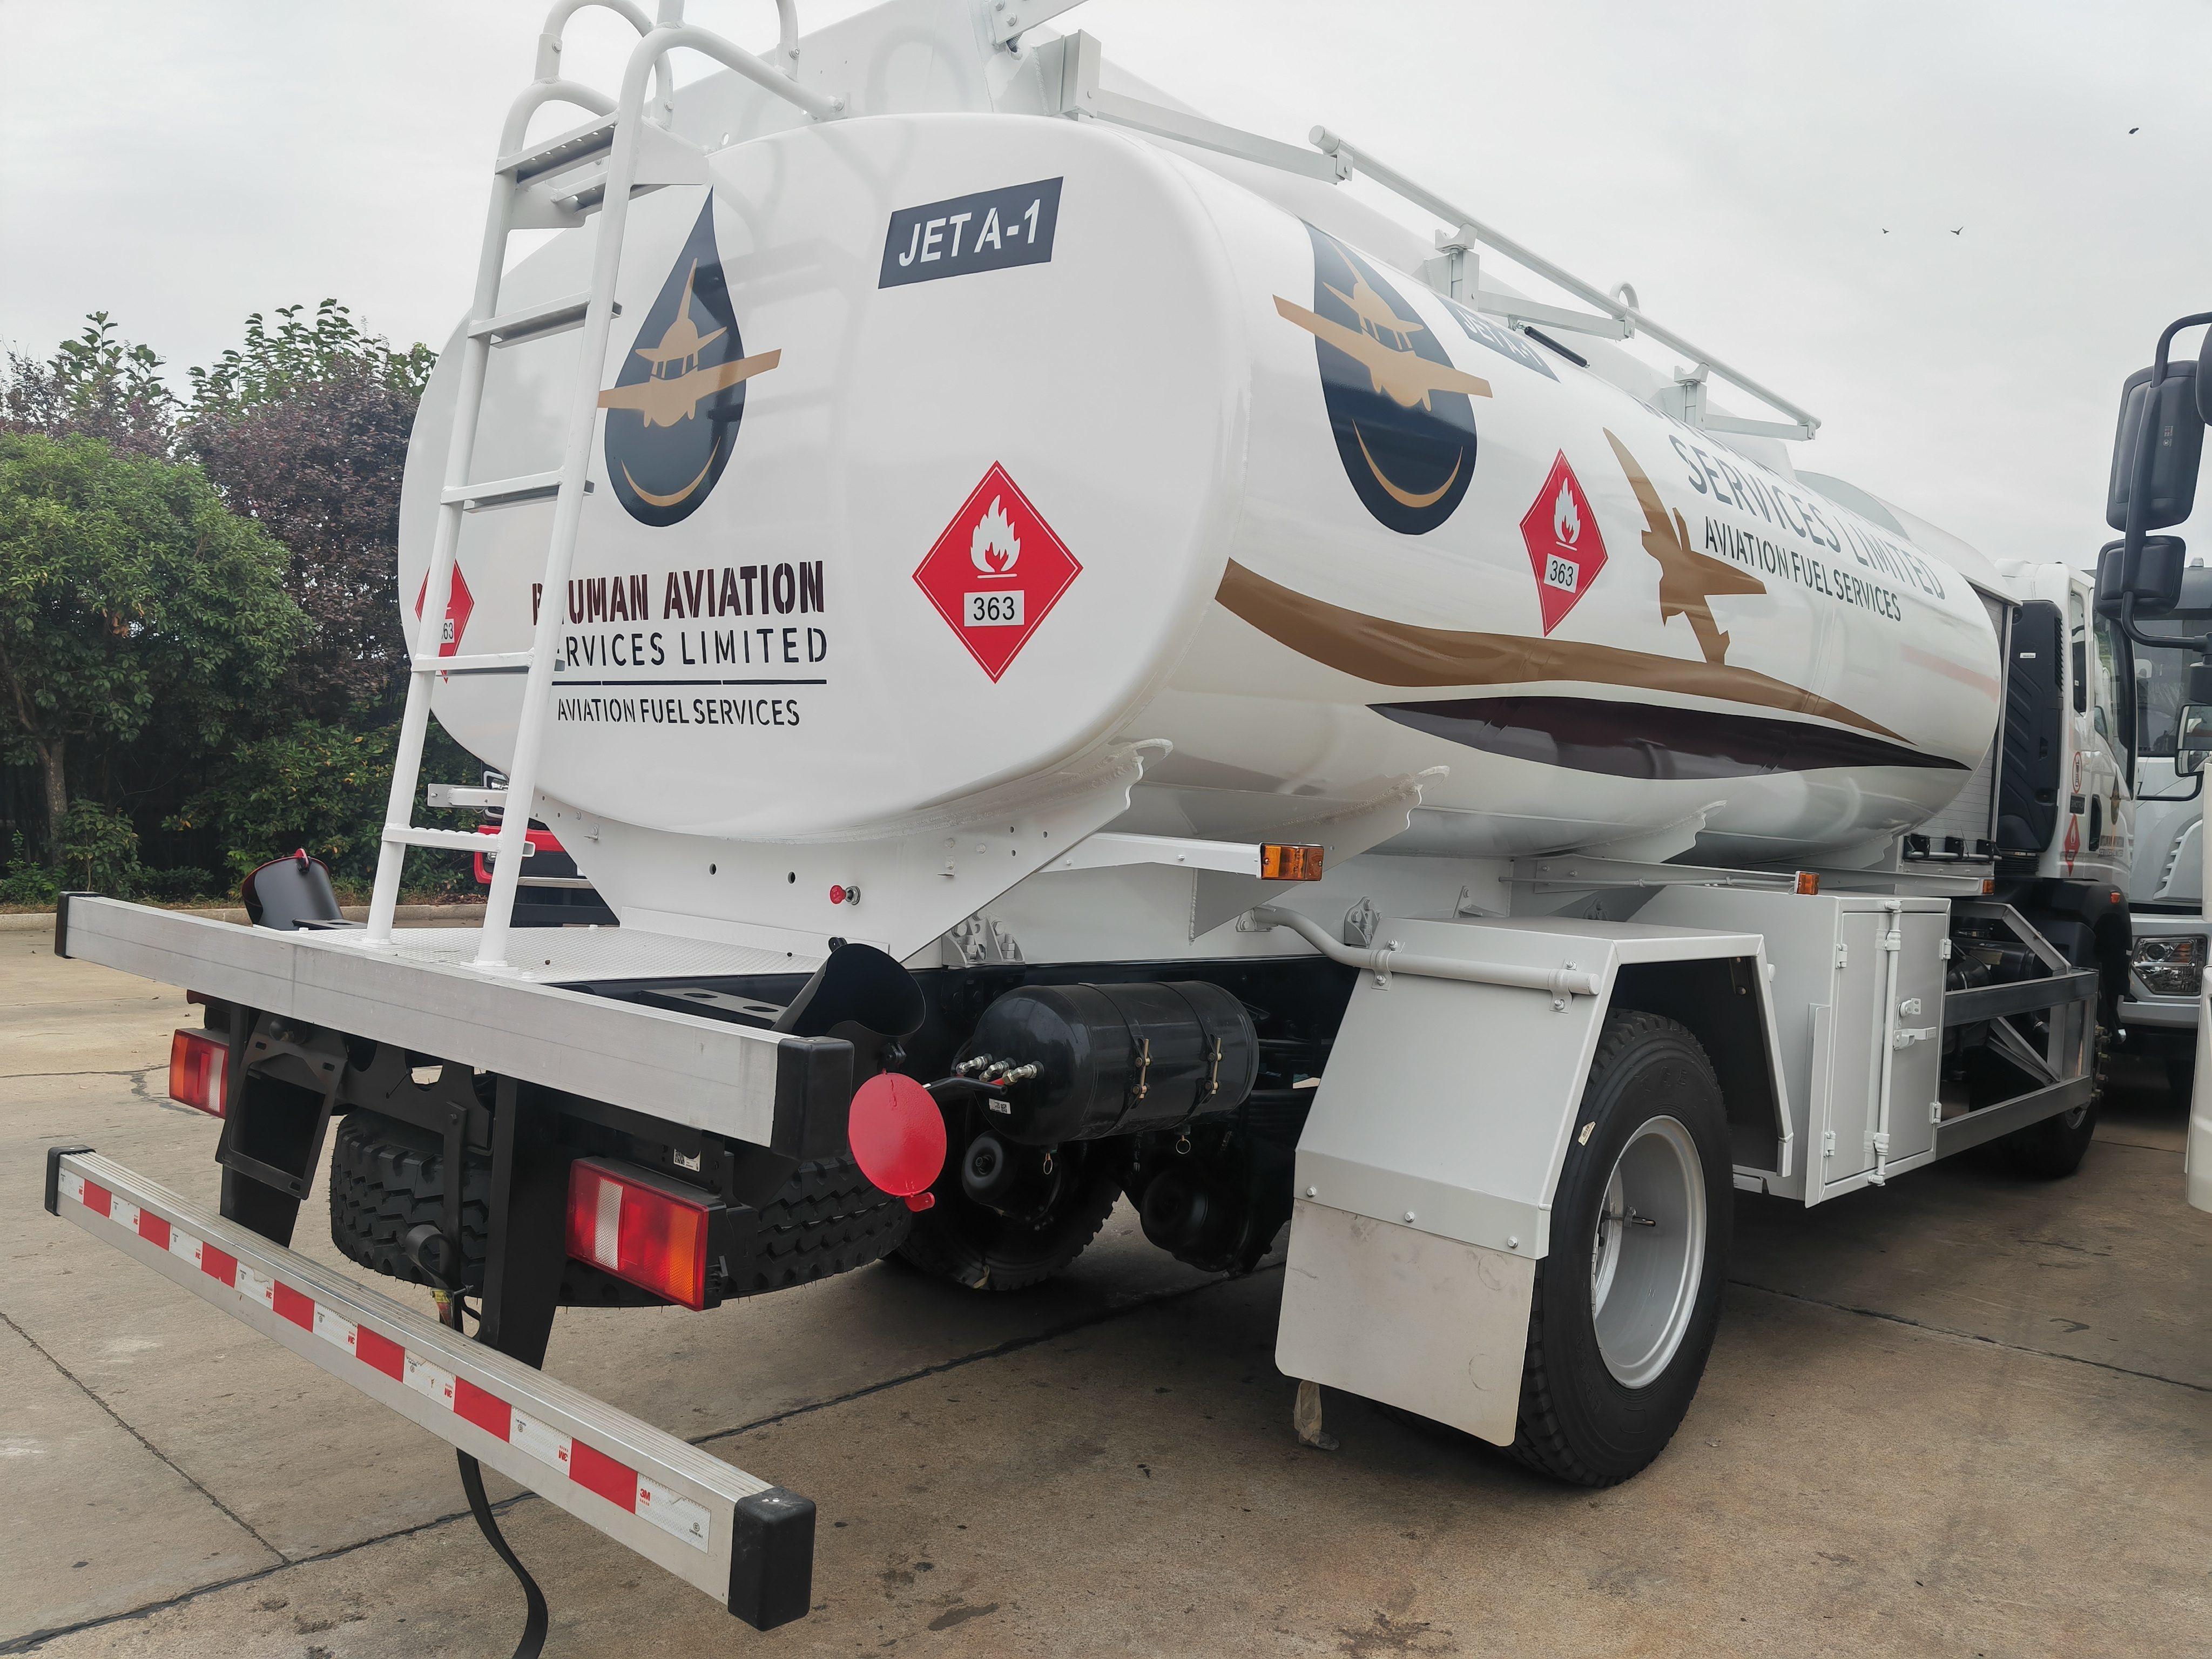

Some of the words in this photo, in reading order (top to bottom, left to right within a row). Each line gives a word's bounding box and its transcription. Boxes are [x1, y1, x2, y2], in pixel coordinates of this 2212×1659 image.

[899, 212, 972, 267] JET
[974, 198, 1041, 253] A-1
[1668, 434, 1843, 554] SERVICES
[1832, 514, 1946, 601] LIMITED
[1550, 560, 1574, 586] 363
[1705, 516, 1790, 580] AVIATION
[1791, 552, 1833, 597] FUEL
[1833, 569, 1901, 622] SERVICES
[532, 574, 649, 626] PUMAN
[663, 560, 825, 619] AVIATION
[973, 596, 1015, 621] 363
[441, 622, 454, 640] 63
[557, 632, 665, 666] RVICES
[681, 627, 827, 665] LIMITED
[558, 698, 636, 723] AVIATION
[639, 699, 690, 724] FUEL
[693, 699, 800, 726] SERVICES
[348, 1334, 355, 1344] 3M
[444, 1387, 453, 1398] 3M
[558, 1449, 568, 1462] 3M
[640, 1488, 651, 1501] 3M
